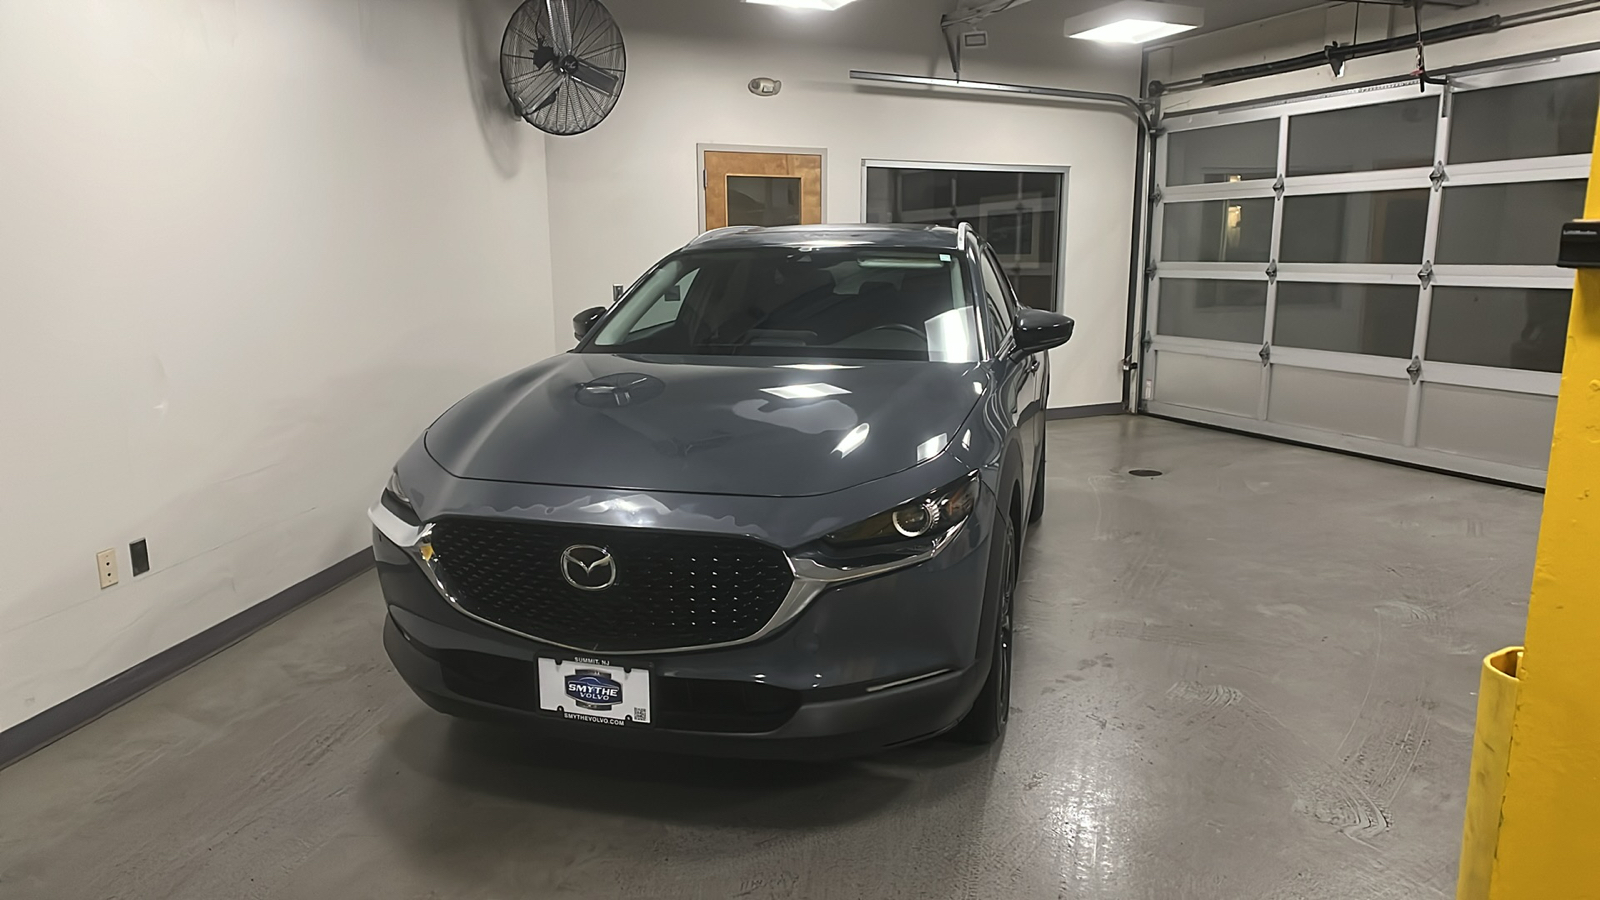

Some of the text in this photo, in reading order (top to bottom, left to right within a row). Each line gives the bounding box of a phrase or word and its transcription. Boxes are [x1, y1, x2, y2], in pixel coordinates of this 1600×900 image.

[568, 683, 618, 697] SMYTHE
[580, 692, 610, 701] VOLVO
[564, 712, 625, 726] SMYTHEVOLVO.COM
